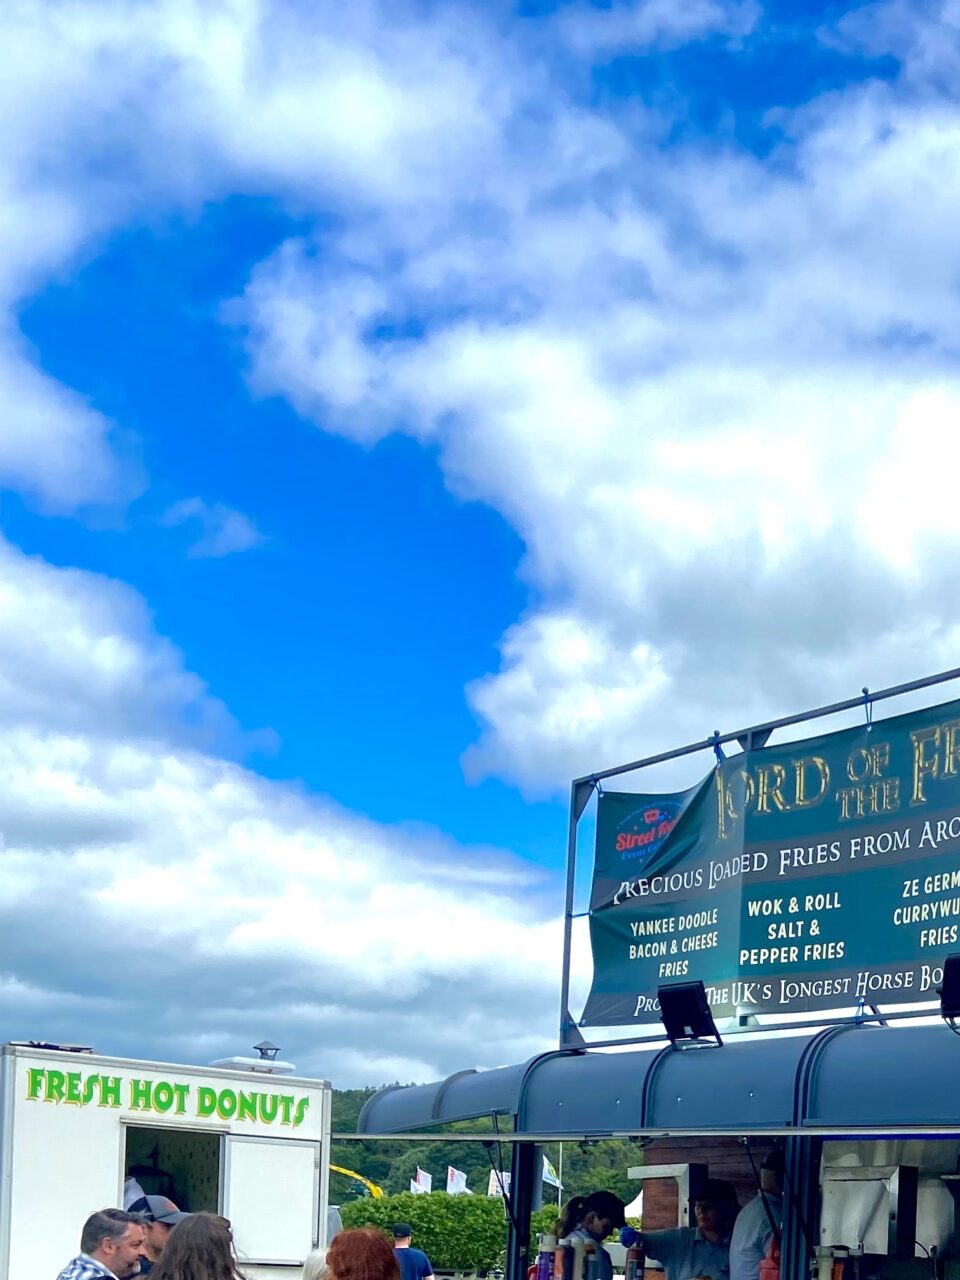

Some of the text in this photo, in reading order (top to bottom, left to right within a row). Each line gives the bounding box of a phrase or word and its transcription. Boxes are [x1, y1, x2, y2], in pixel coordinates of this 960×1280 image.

[846, 743, 890, 781] OF
[836, 778, 900, 821] THE
[616, 827, 656, 851] Street
[613, 869, 703, 905] PRECIOUS
[708, 852, 768, 890] LOADED
[778, 840, 841, 876] FRIES
[849, 828, 911, 860] FROM
[902, 878, 919, 898] ZE
[747, 892, 842, 917] WOK & ROLL
[630, 908, 719, 937] YANKEE DOODLE
[767, 919, 820, 940] SALT &
[919, 924, 958, 947] FRIES
[629, 931, 719, 960] BACON & CHEESE
[739, 941, 845, 966] PEPPER FRIES
[658, 960, 689, 978] FRIES
[704, 986, 729, 1006] THE
[732, 981, 772, 1006] UK'S
[778, 978, 852, 1004] LONGEST
[854, 971, 914, 998] HORSE
[919, 965, 944, 992] BO
[26, 1067, 310, 1127] FRESH HOT DONUTS
